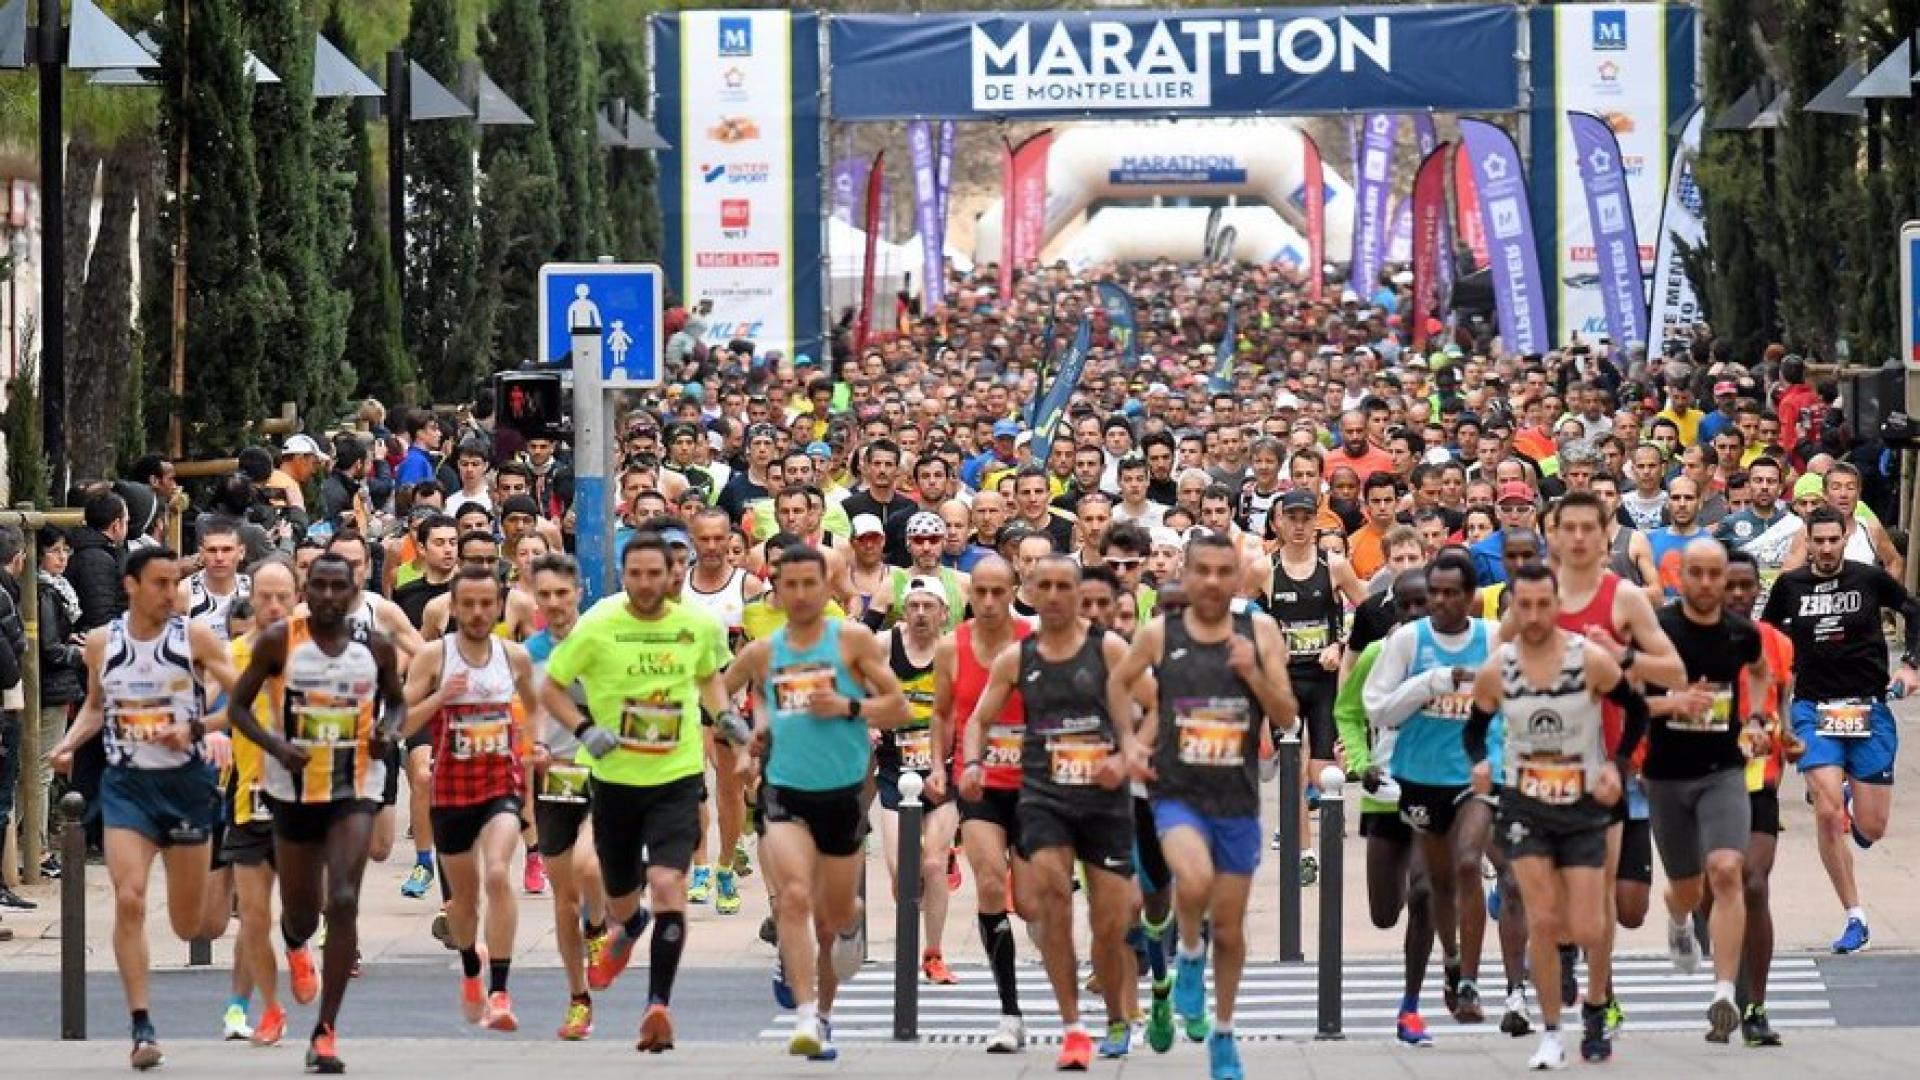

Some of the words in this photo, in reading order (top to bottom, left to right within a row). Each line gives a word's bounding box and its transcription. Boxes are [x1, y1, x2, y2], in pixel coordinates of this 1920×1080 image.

[972, 16, 1391, 76] MARATHON
[985, 84, 1014, 100] DE
[1027, 82, 1195, 100] MONTPELLIER
[1121, 155, 1235, 170] MARATHON
[626, 664, 685, 676] CANCER
[1824, 717, 1866, 731] 2685
